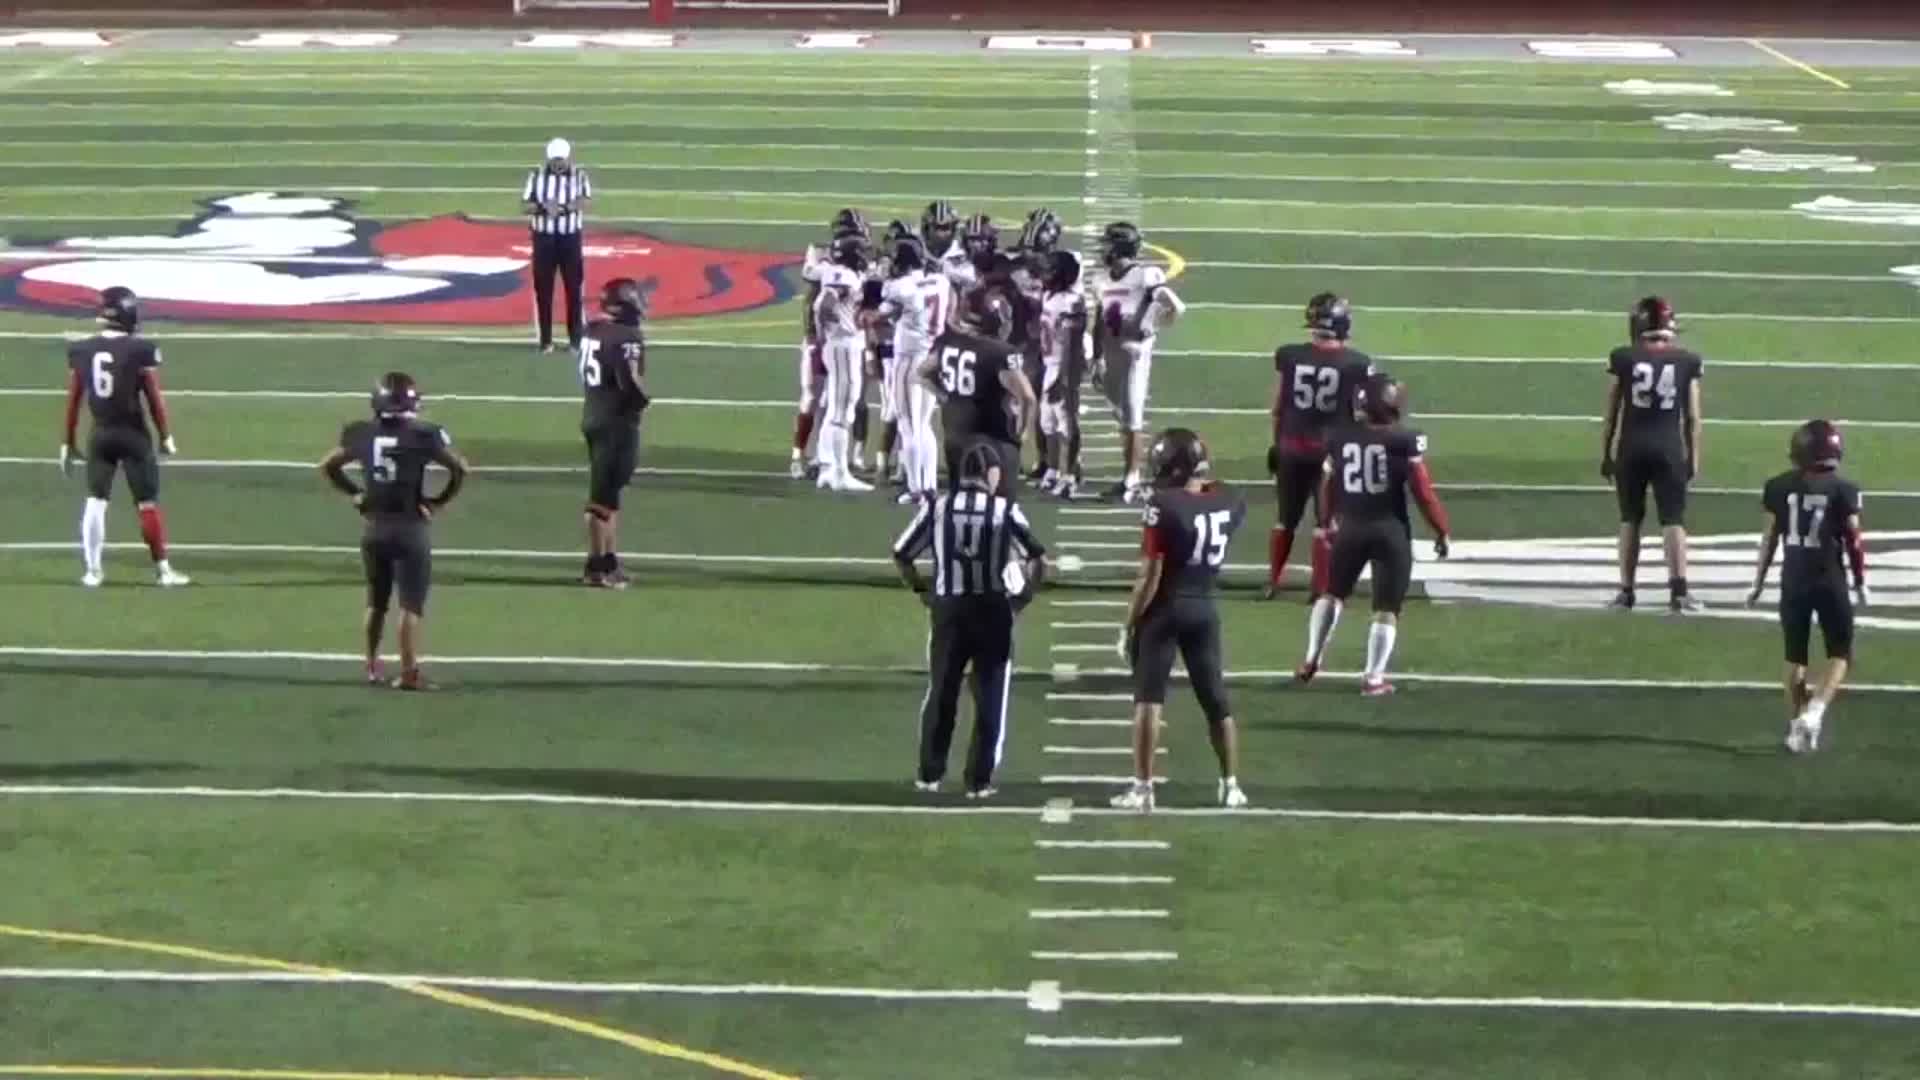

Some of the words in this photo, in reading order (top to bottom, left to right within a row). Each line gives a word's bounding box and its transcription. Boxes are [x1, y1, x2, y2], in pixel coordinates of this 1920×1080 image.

[92, 351, 114, 398] 6
[941, 347, 976, 393] 56
[1294, 365, 1339, 411] 52
[1632, 362, 1676, 409] 24
[373, 436, 398, 481] 5
[1342, 443, 1388, 494] 20
[1192, 511, 1230, 566] 15
[1787, 493, 1828, 547] 17
